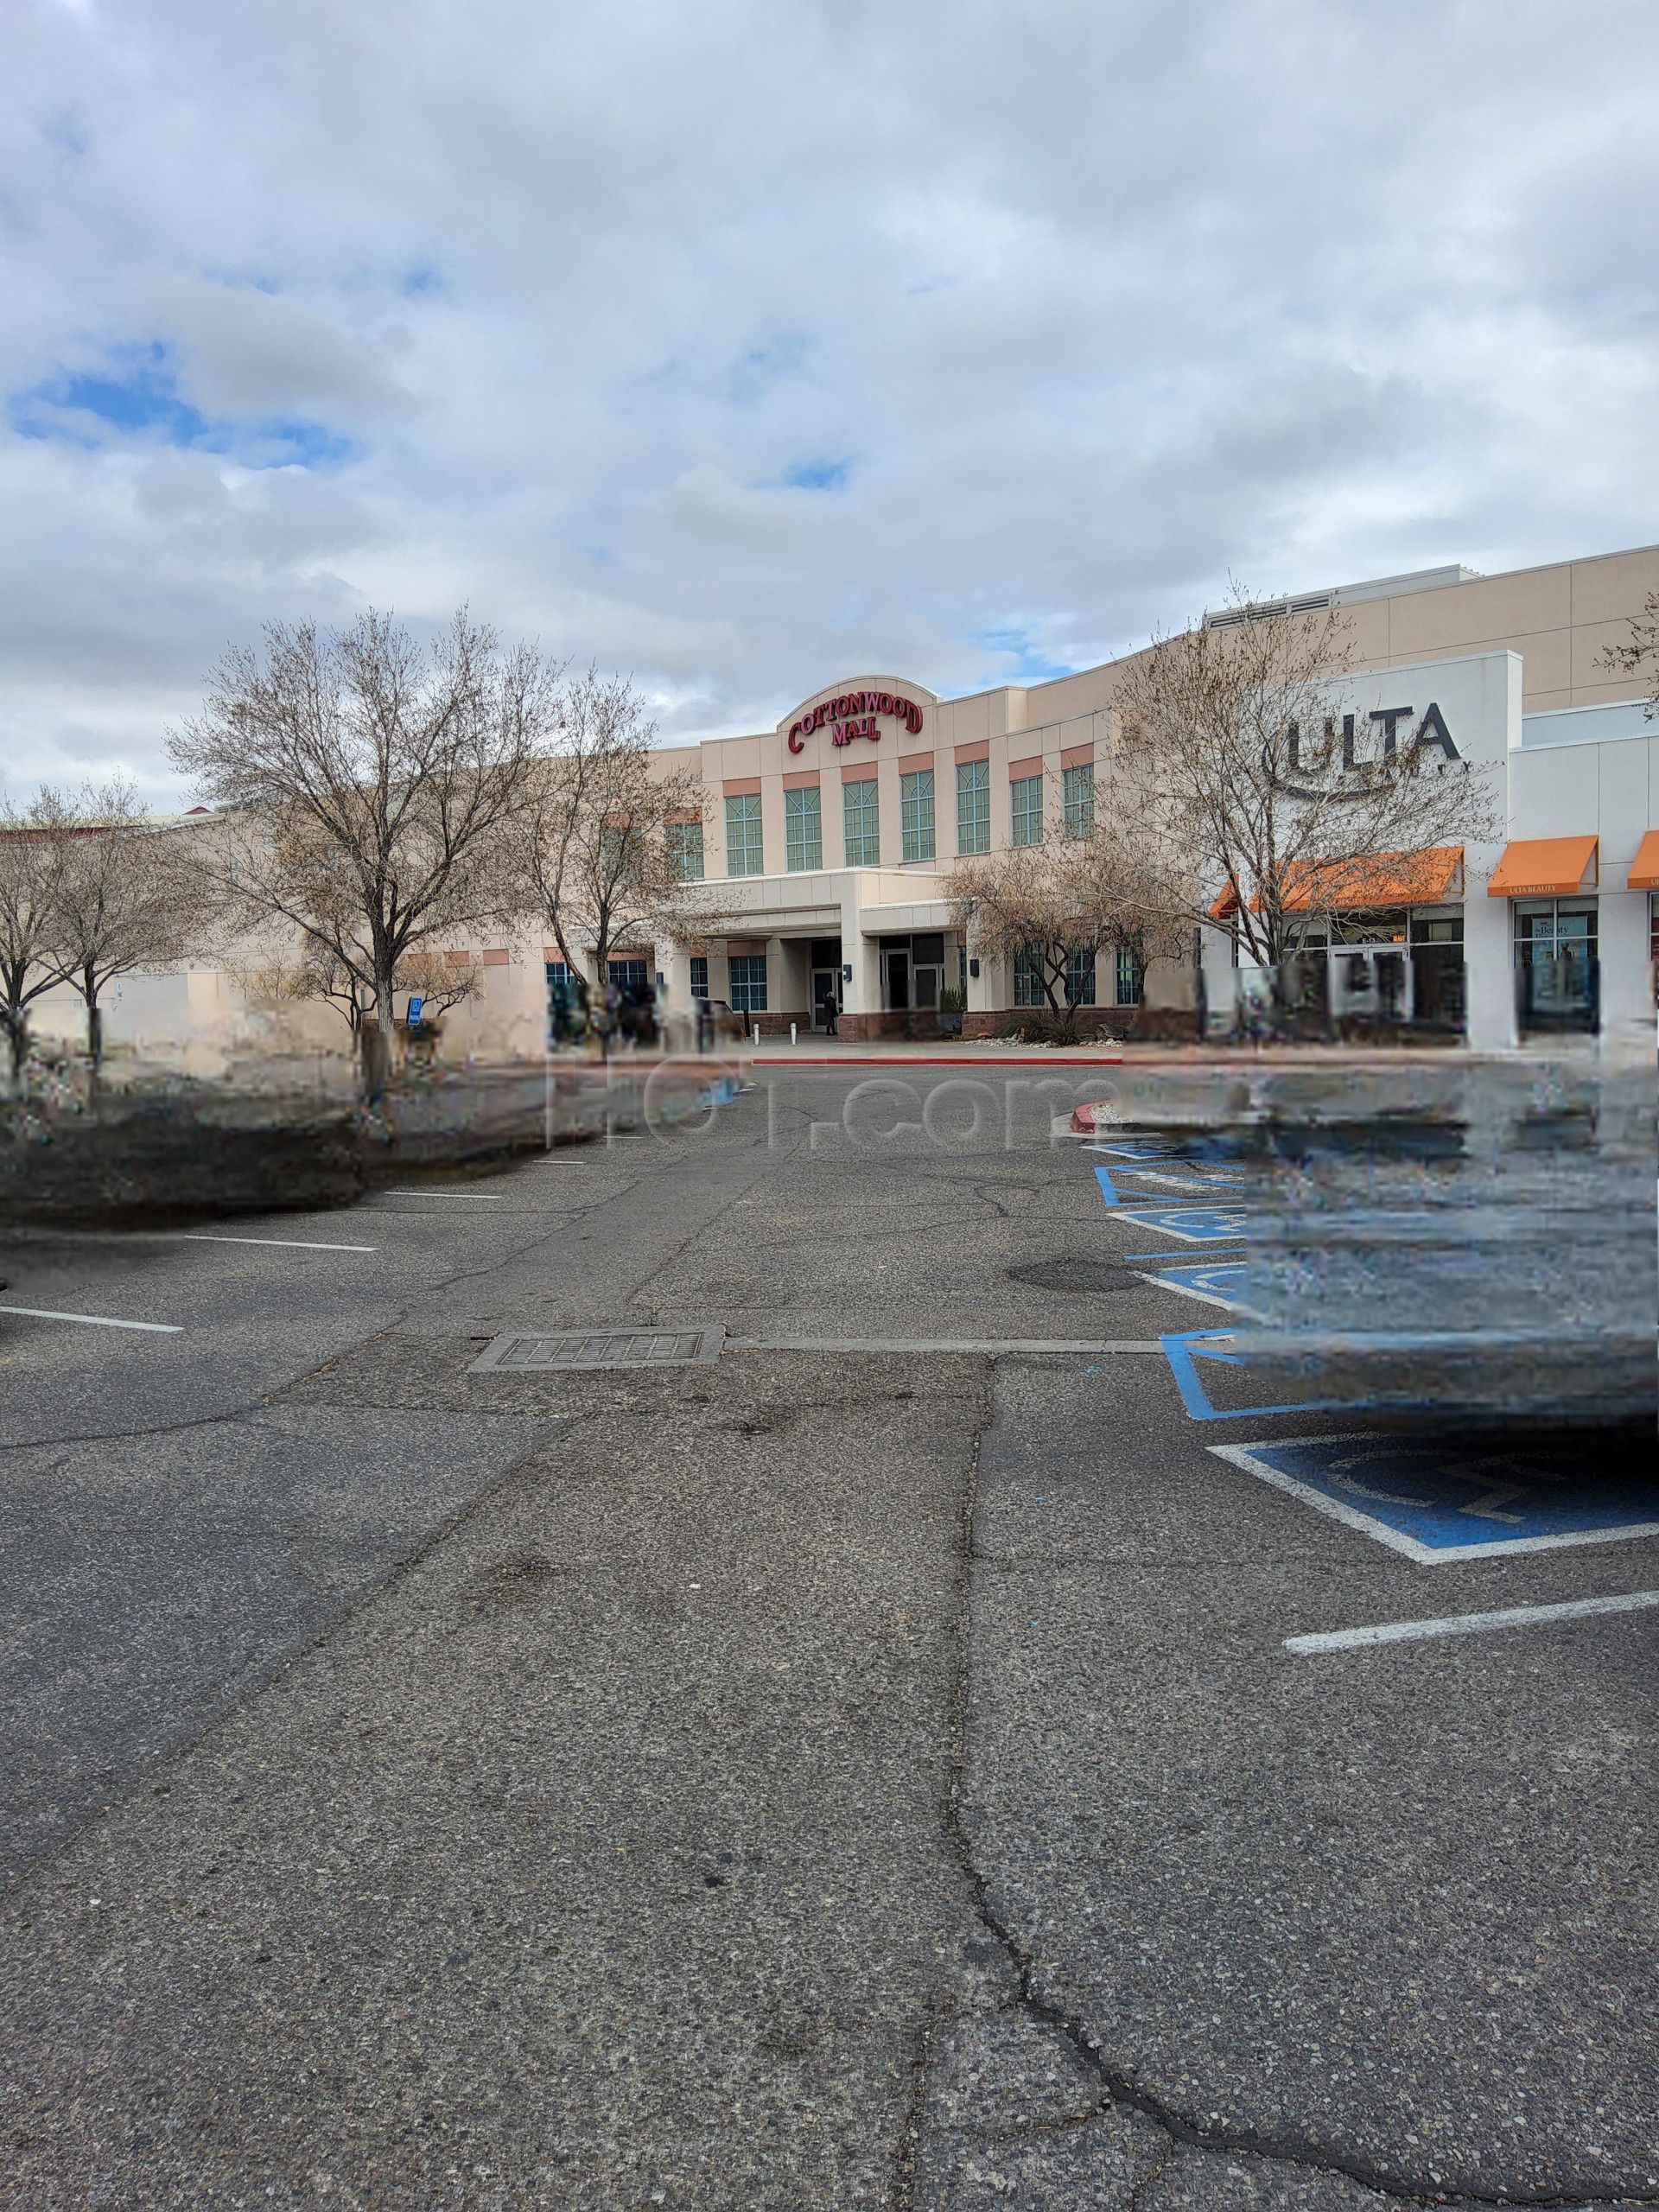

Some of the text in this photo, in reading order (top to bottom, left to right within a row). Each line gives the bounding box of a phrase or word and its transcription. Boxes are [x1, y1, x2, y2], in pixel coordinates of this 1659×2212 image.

[788, 691, 923, 753] COTTONWOOD
[831, 715, 880, 746] MALL
[1287, 702, 1461, 772] ULTA
[1510, 884, 1555, 894] ULTA BEAUTY
